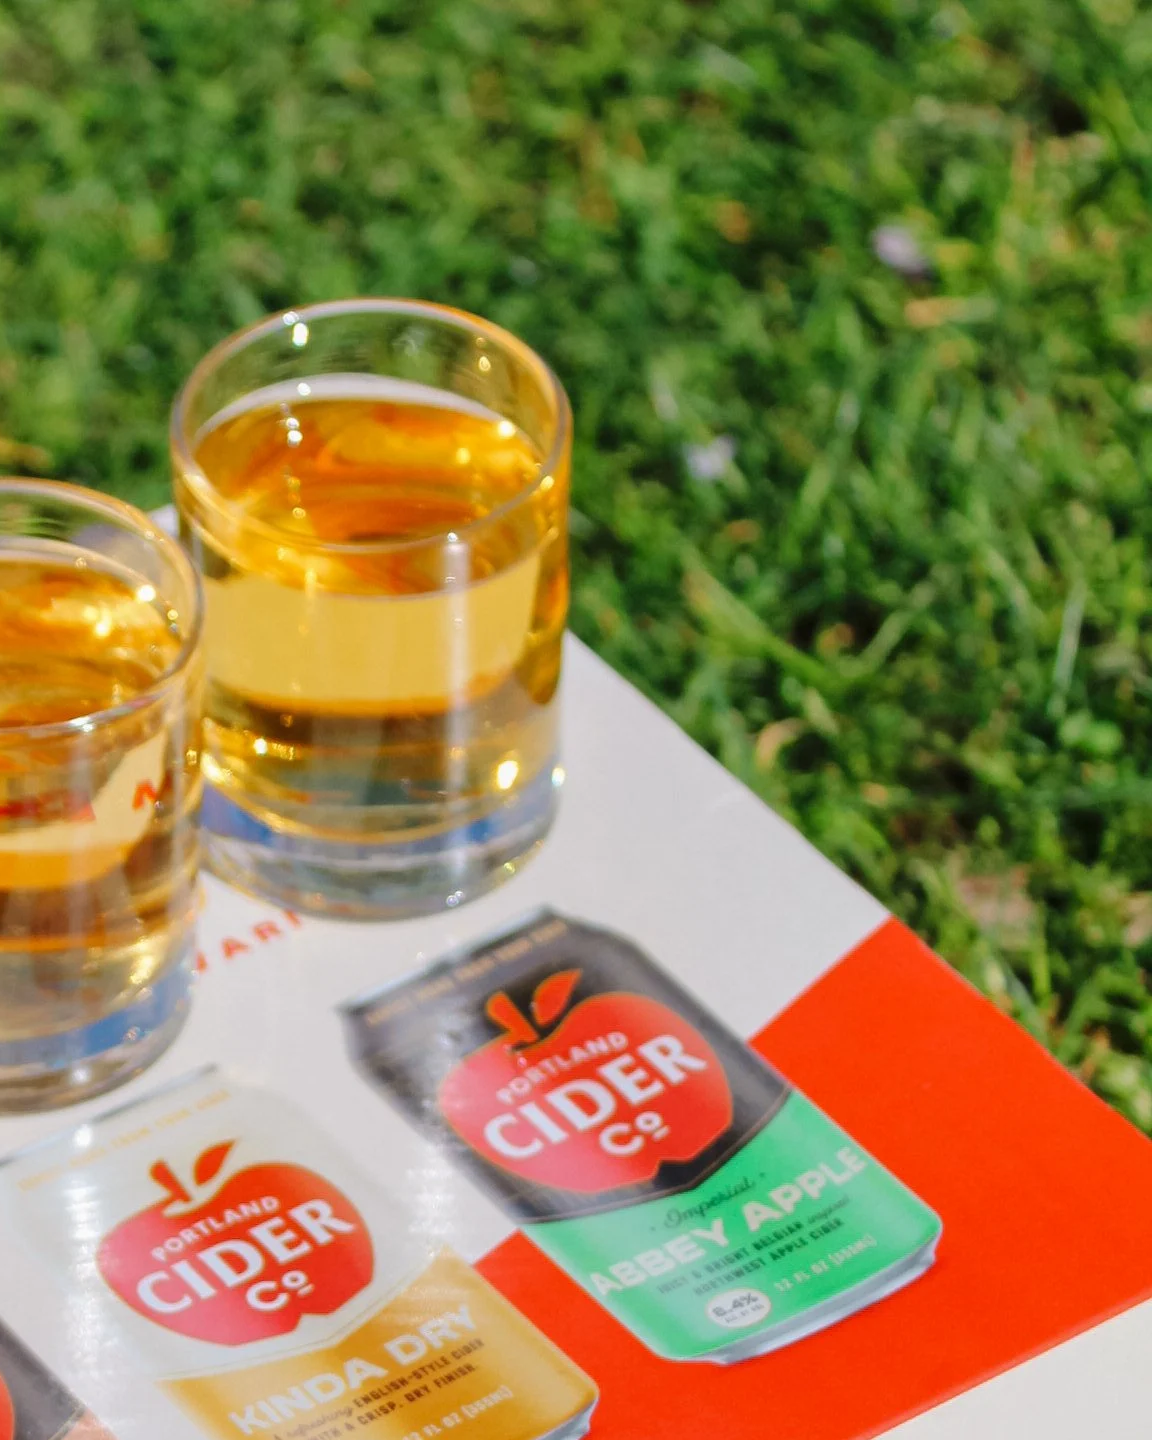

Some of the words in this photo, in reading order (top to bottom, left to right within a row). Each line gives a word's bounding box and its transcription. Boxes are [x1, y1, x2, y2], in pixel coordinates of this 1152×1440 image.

[483, 1034, 708, 1160] CIDER
[496, 1031, 629, 1104] PORTLAND
[136, 1199, 355, 1314] CIDER
[151, 1196, 280, 1262] PORTLAND
[589, 1218, 730, 1296] ABBEY
[742, 1147, 866, 1232] APPLE
[664, 1176, 755, 1229] Imperial
[229, 1357, 389, 1435] KINDA
[384, 1304, 476, 1367] DRY
